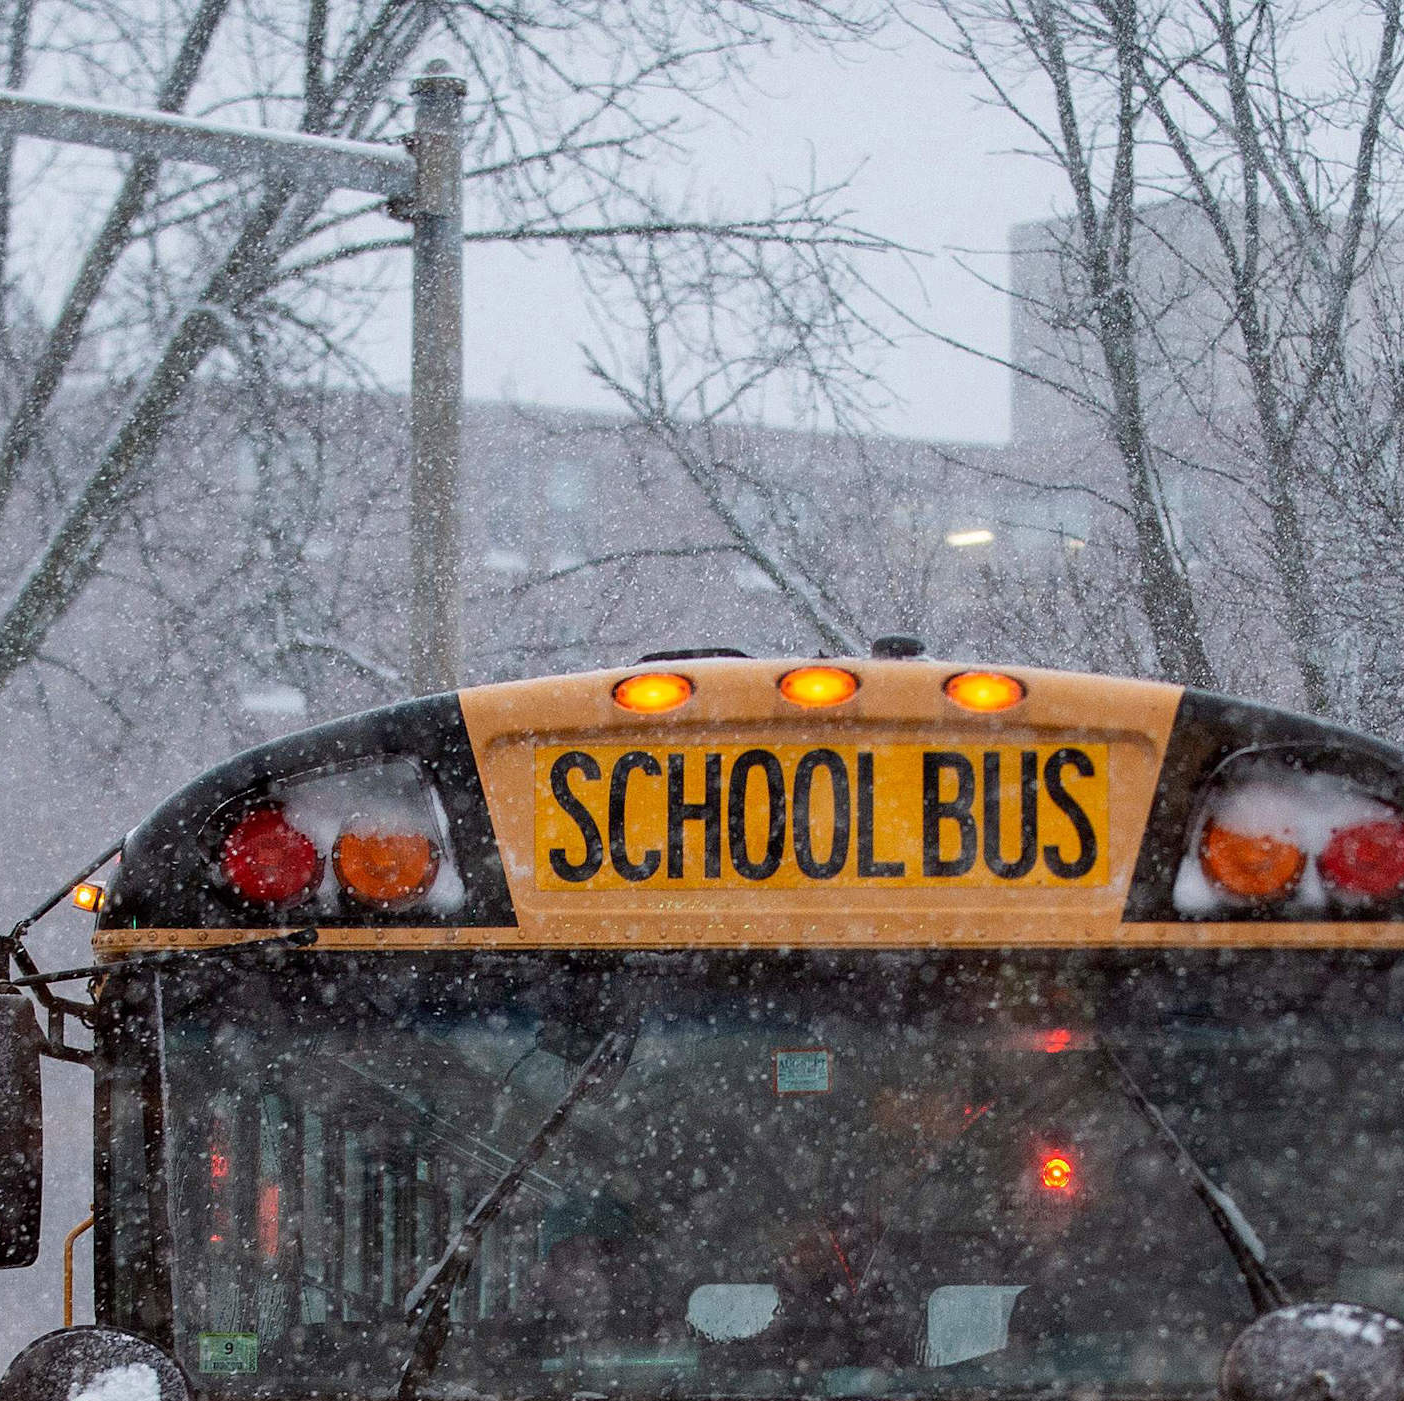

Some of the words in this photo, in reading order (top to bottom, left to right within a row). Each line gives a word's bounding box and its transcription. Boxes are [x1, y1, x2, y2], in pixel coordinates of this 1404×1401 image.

[548, 748, 905, 883] SCHOOL
[922, 748, 1096, 880] BUS
[224, 1342, 234, 1355] 9
